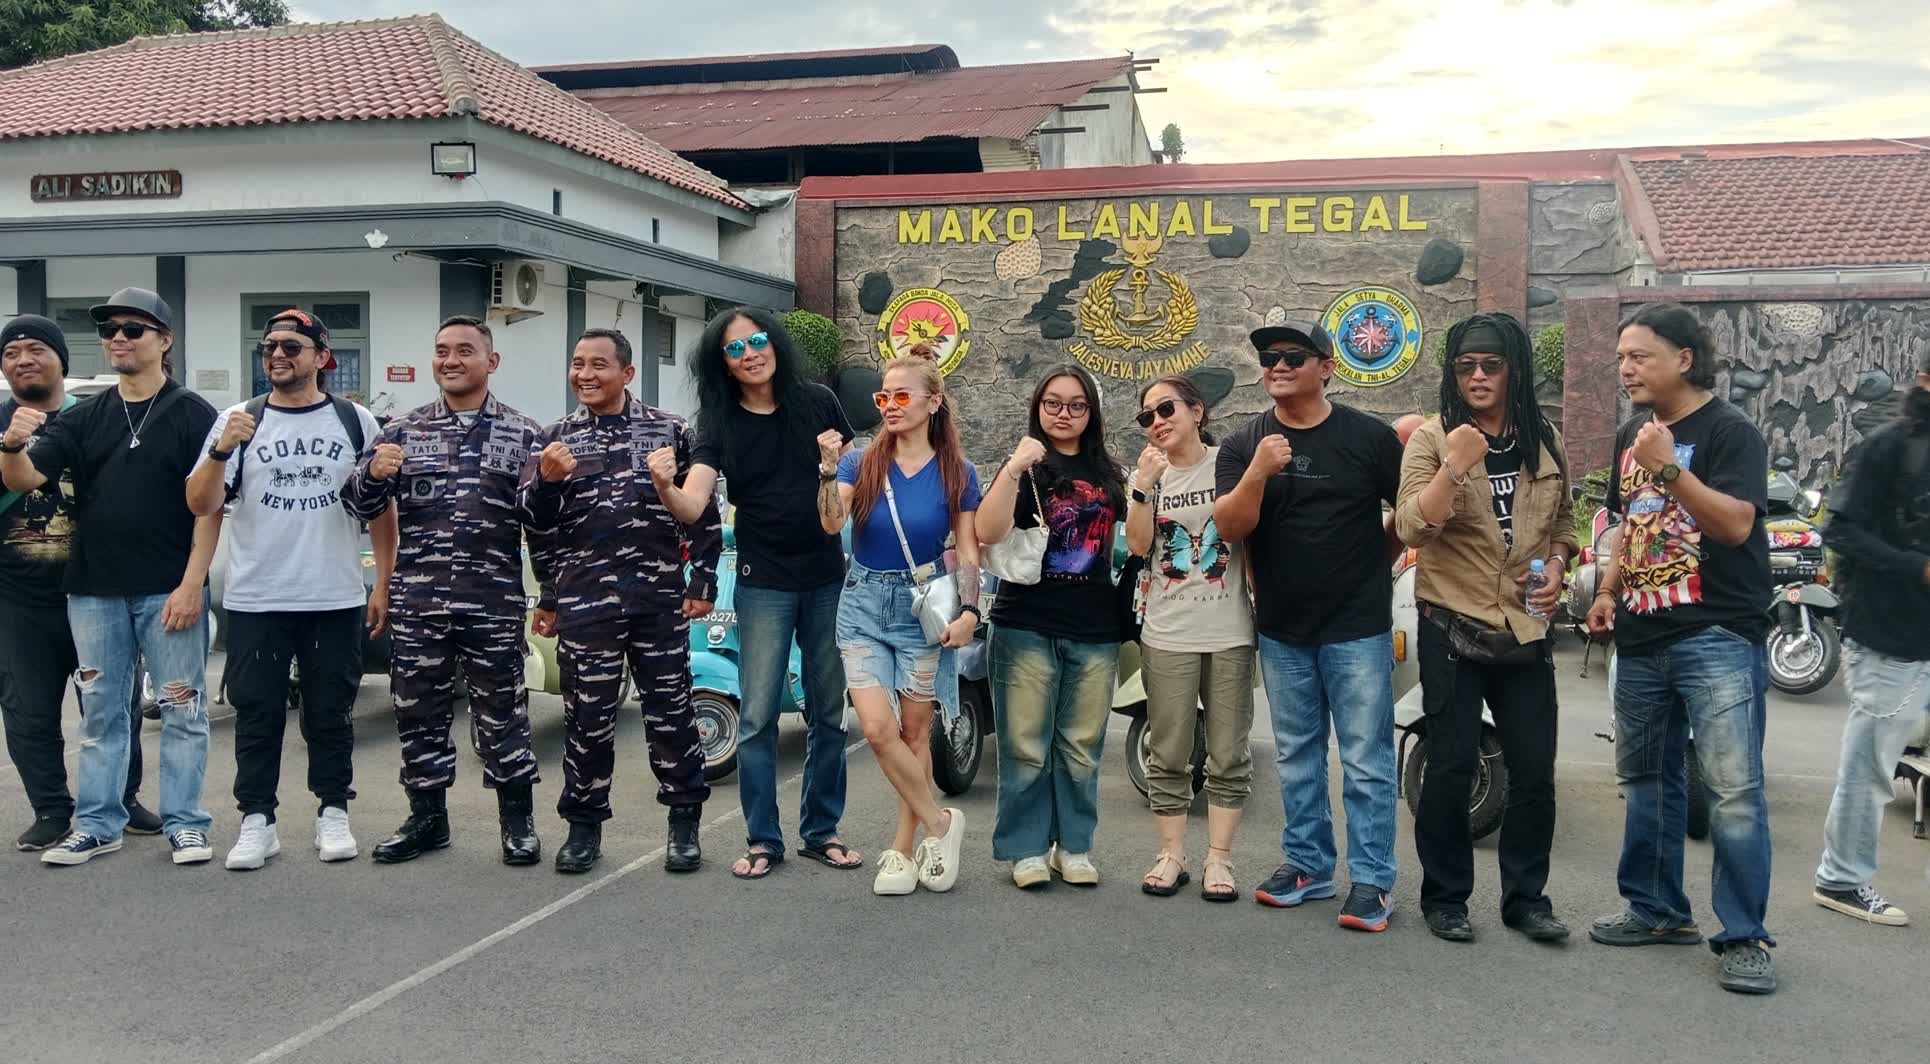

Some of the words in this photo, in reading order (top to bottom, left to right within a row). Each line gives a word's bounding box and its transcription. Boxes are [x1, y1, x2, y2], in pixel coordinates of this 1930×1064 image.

[38, 176, 71, 198] ALI
[80, 173, 171, 197] SADIKIN
[898, 207, 1034, 244] MAKO
[1058, 200, 1234, 241] LANAL
[1249, 195, 1428, 233] TEGAL
[1334, 301, 1349, 317] JALA
[1355, 292, 1376, 301] SETYA
[1385, 294, 1410, 316] DHARMA
[1069, 341, 1133, 380] JALESVEVA
[1136, 340, 1211, 379] JAYAMAHE
[1392, 356, 1411, 374] TEGAL
[256, 437, 344, 463] COACH
[412, 445, 439, 455] TATO
[489, 444, 505, 454] TNI
[509, 448, 521, 458] AL
[633, 441, 654, 449] TNI
[260, 491, 296, 511] NEW
[299, 490, 339, 511] YORK
[1163, 488, 1215, 511] ROXETT
